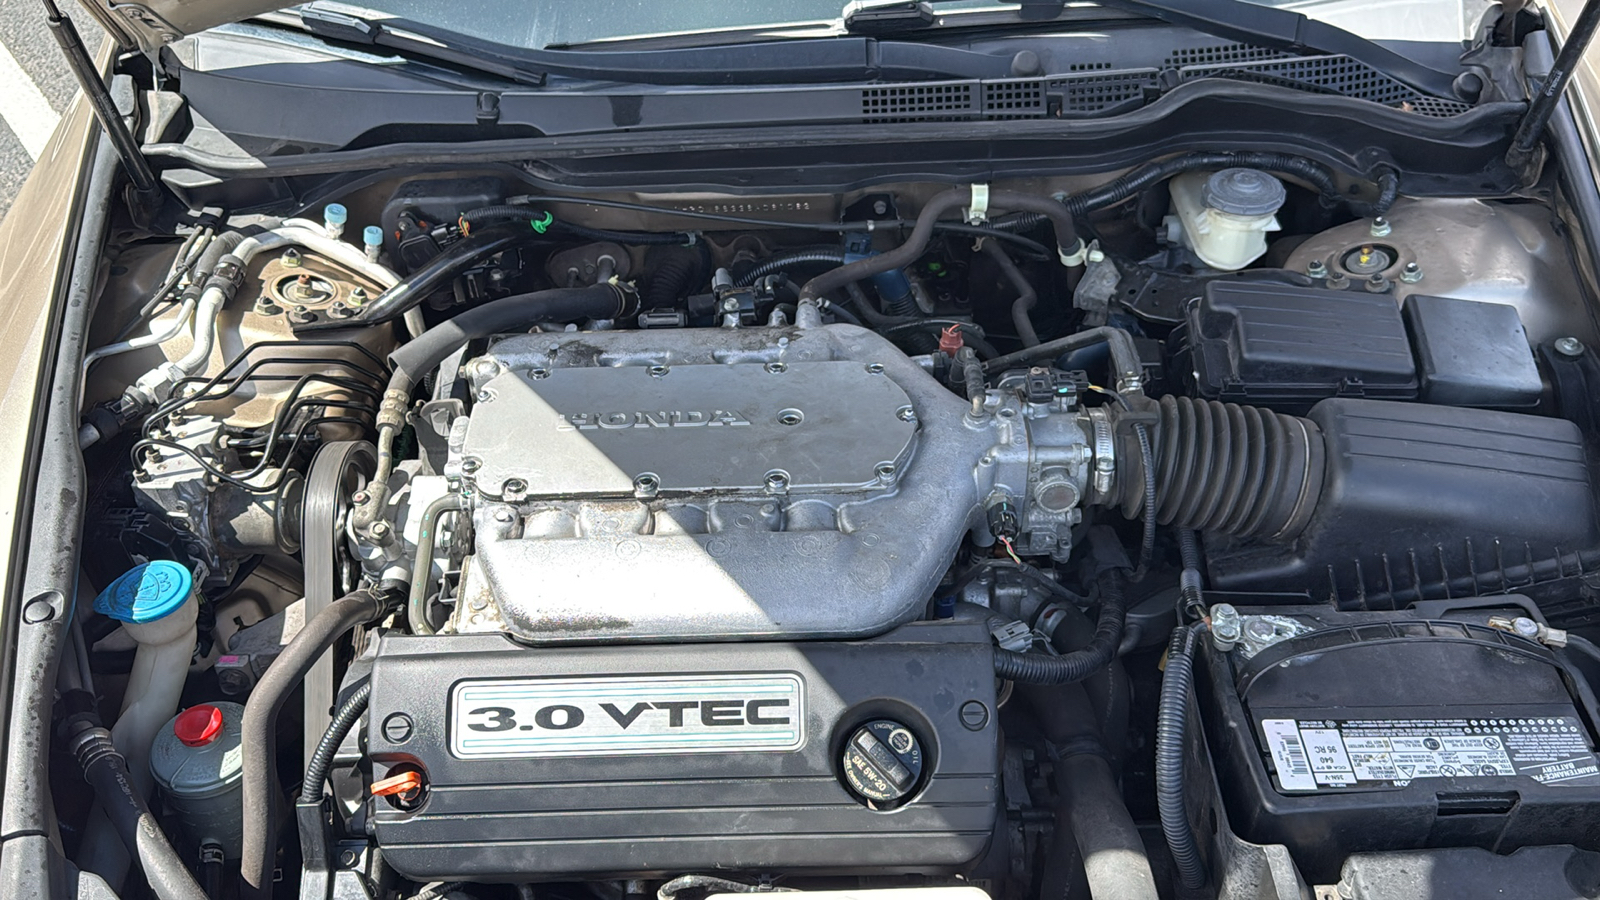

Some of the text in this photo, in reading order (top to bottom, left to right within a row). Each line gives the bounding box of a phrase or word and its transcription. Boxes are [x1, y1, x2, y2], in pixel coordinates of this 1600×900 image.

[556, 410, 751, 430] HONDA
[467, 698, 790, 732] 3.0 VTEC
[852, 755, 887, 791] SAE 5W-20
[1530, 766, 1598, 781] MAINTENANCE-FR
[1542, 762, 1575, 773] BATTERY
